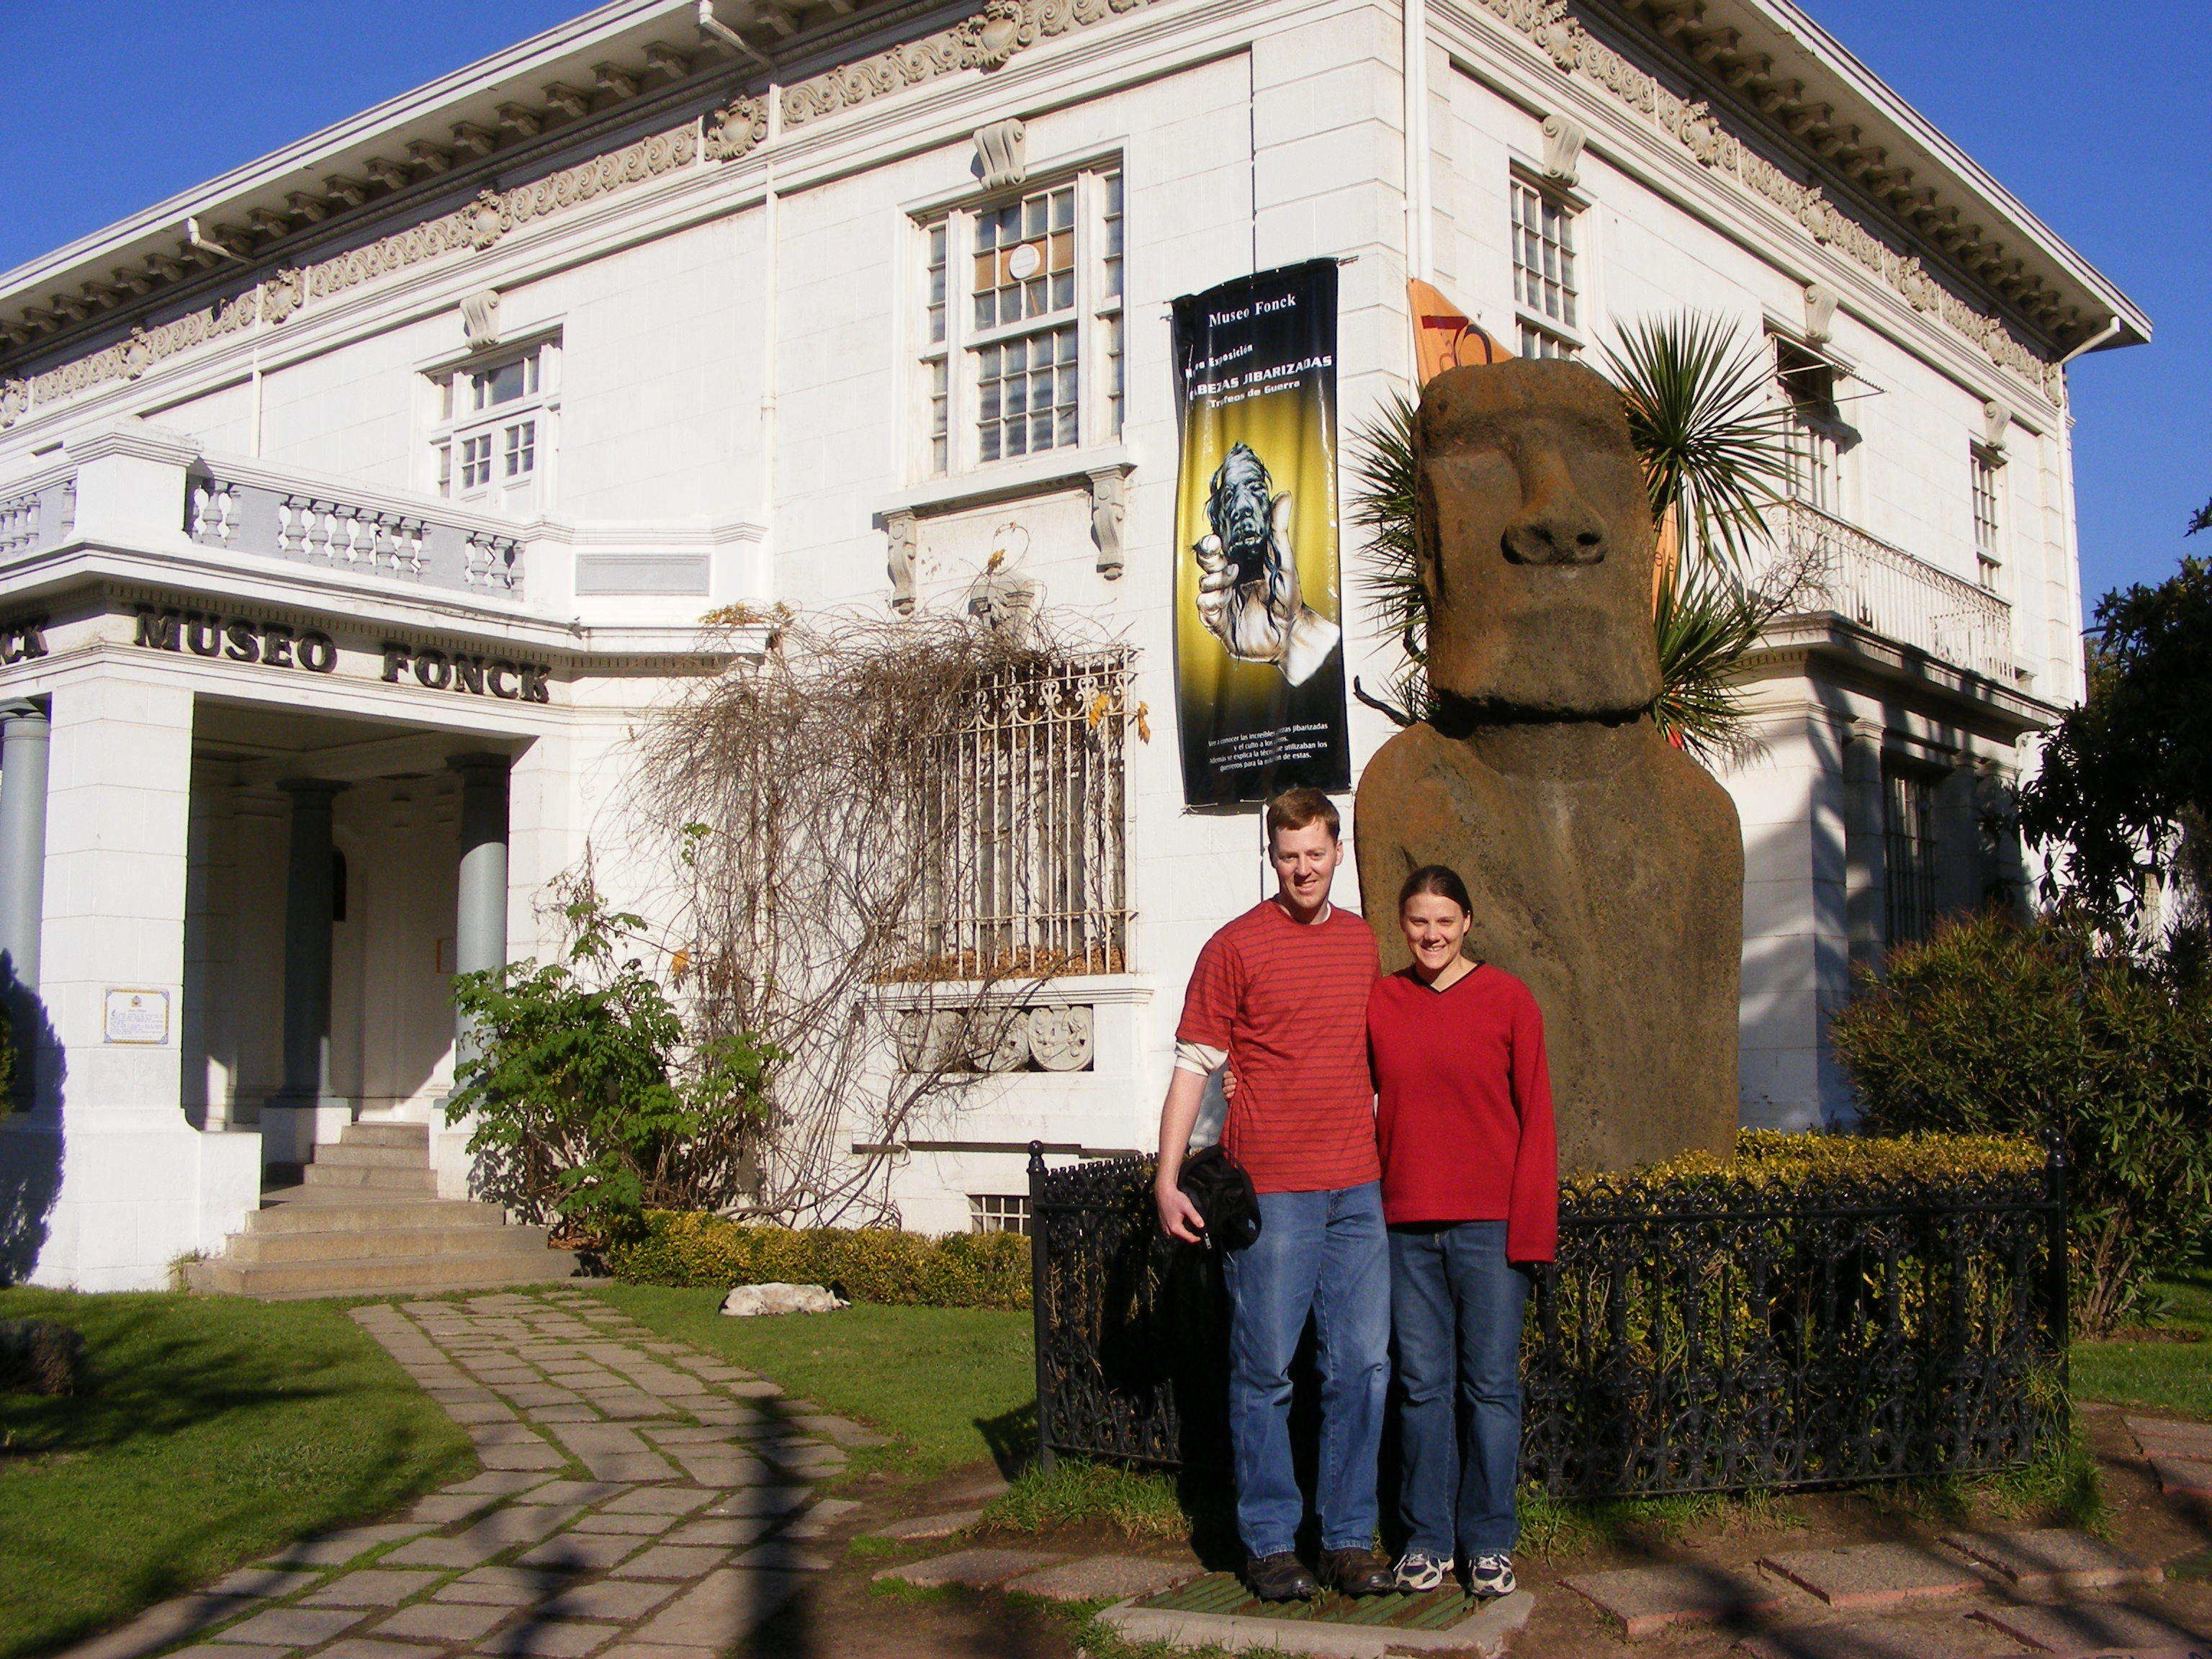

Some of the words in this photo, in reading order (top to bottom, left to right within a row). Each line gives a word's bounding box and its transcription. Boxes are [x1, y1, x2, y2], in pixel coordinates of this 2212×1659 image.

[1208, 307, 1251, 328] Museo
[1254, 292, 1297, 316] Fonck
[1242, 355, 1332, 385] JIBARIZADAS
[1247, 387, 1261, 397] de
[1264, 380, 1300, 394] Guerra
[134, 606, 338, 673] MUSEO
[381, 642, 552, 703] FONCK
[1292, 723, 1328, 733] jibarizadas
[1285, 742, 1316, 751] utilizaban
[1244, 760, 1256, 769] para
